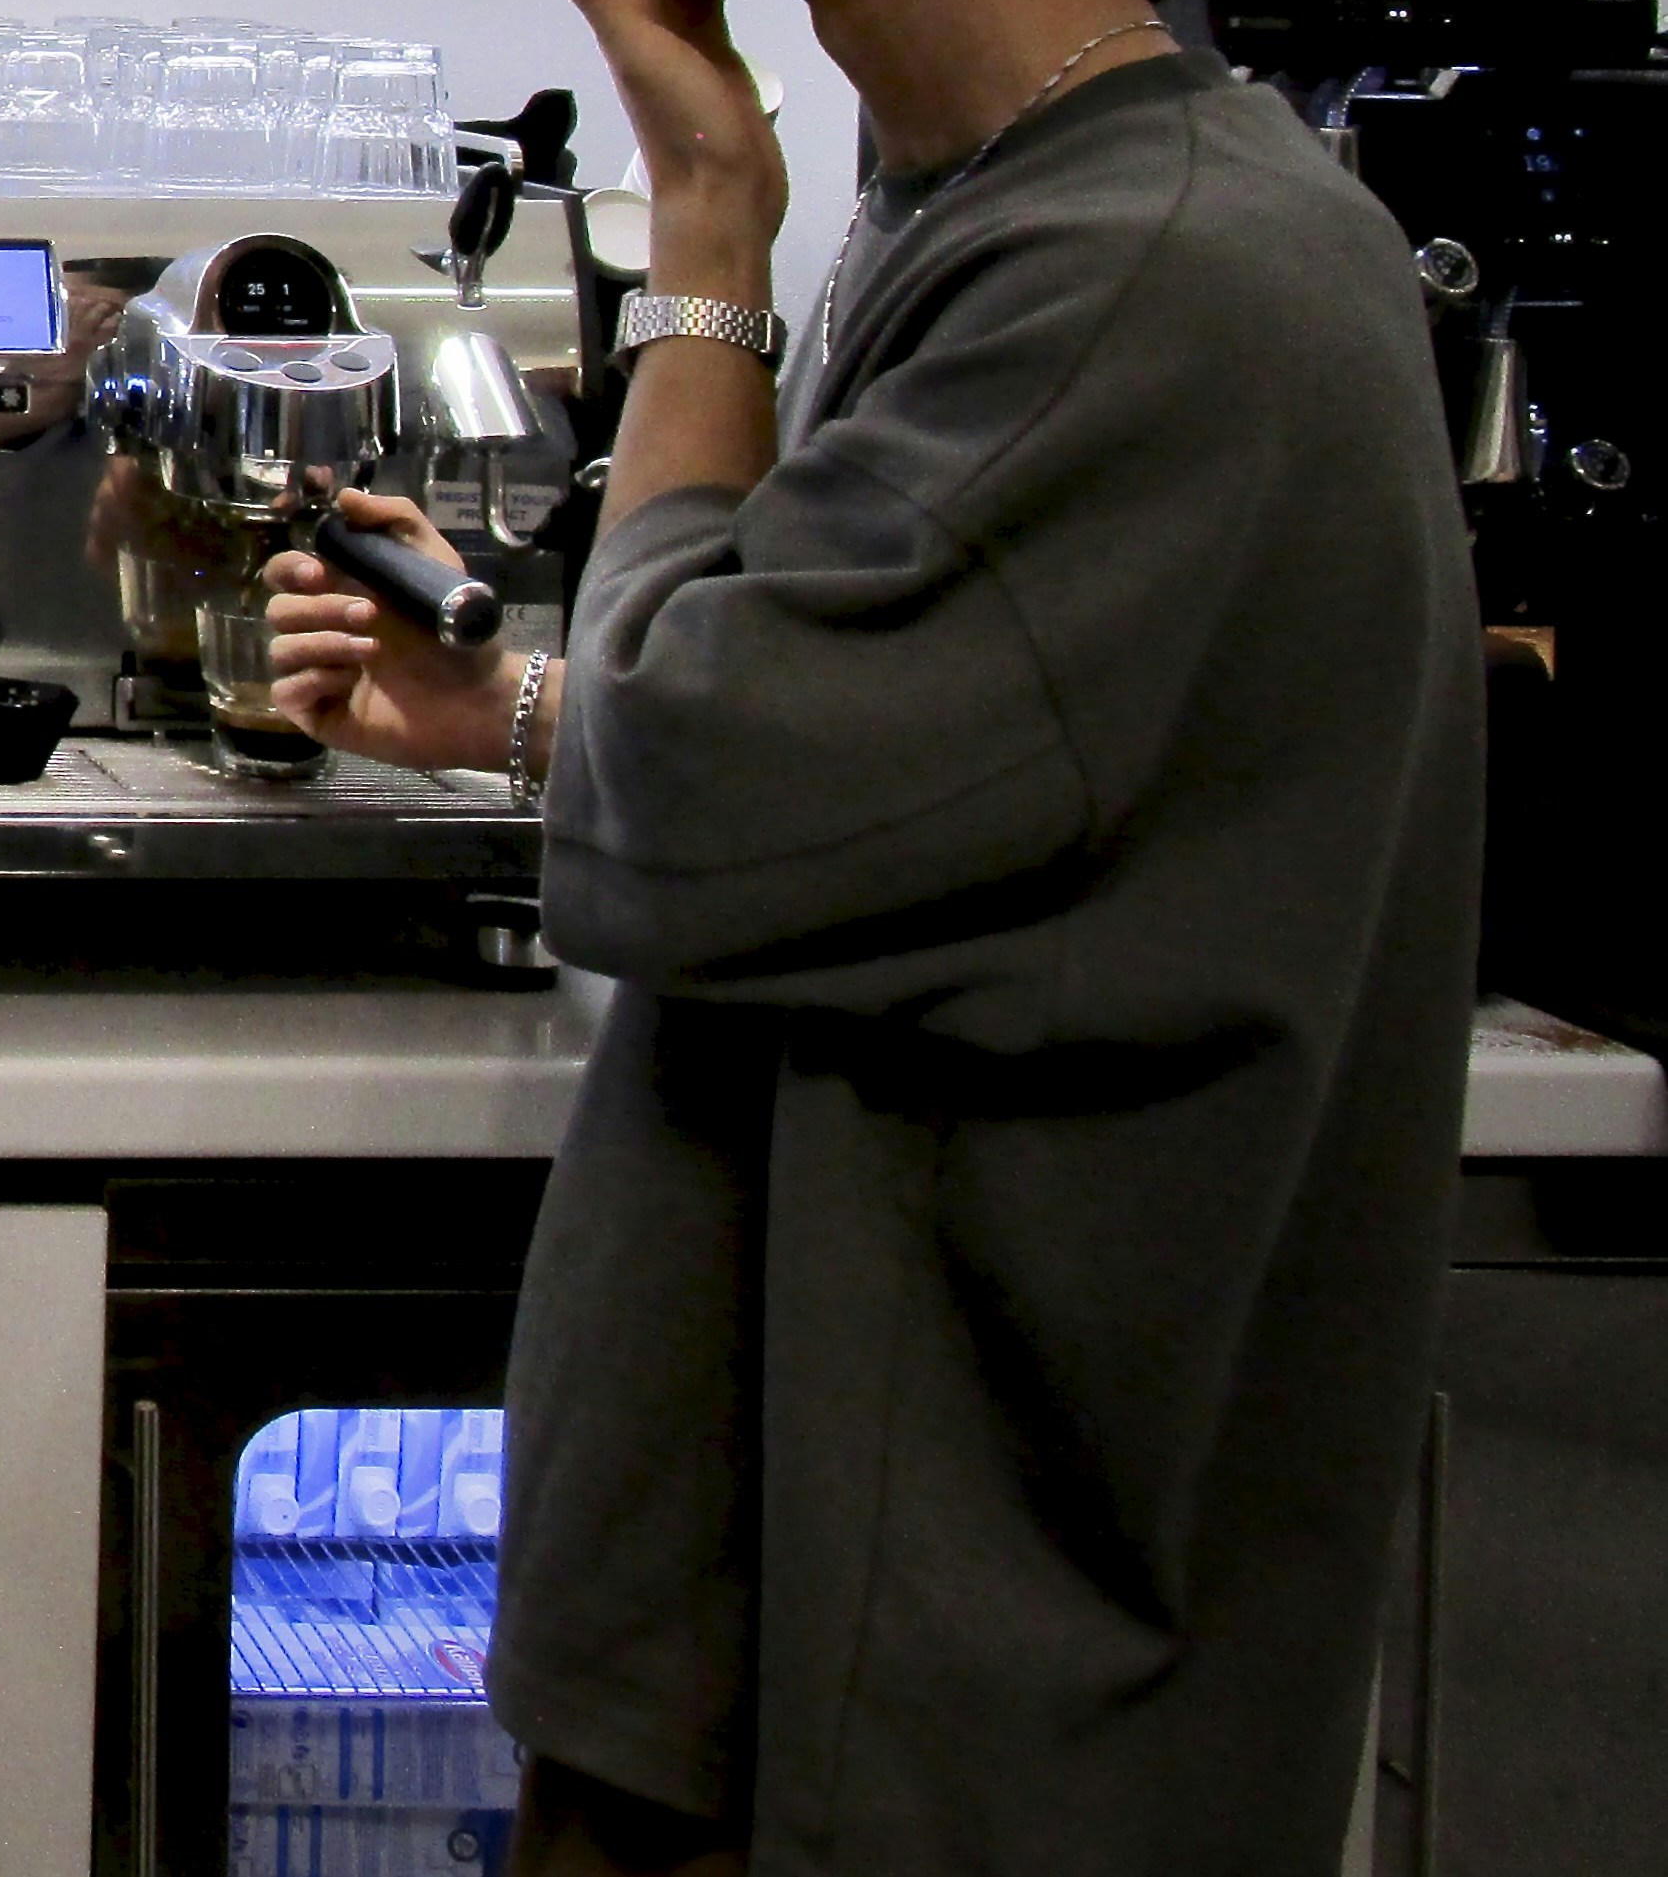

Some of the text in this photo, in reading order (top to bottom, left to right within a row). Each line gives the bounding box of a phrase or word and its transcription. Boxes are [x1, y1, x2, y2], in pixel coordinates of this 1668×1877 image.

[1524, 154, 1550, 172] 19
[248, 283, 290, 296] 25 1
